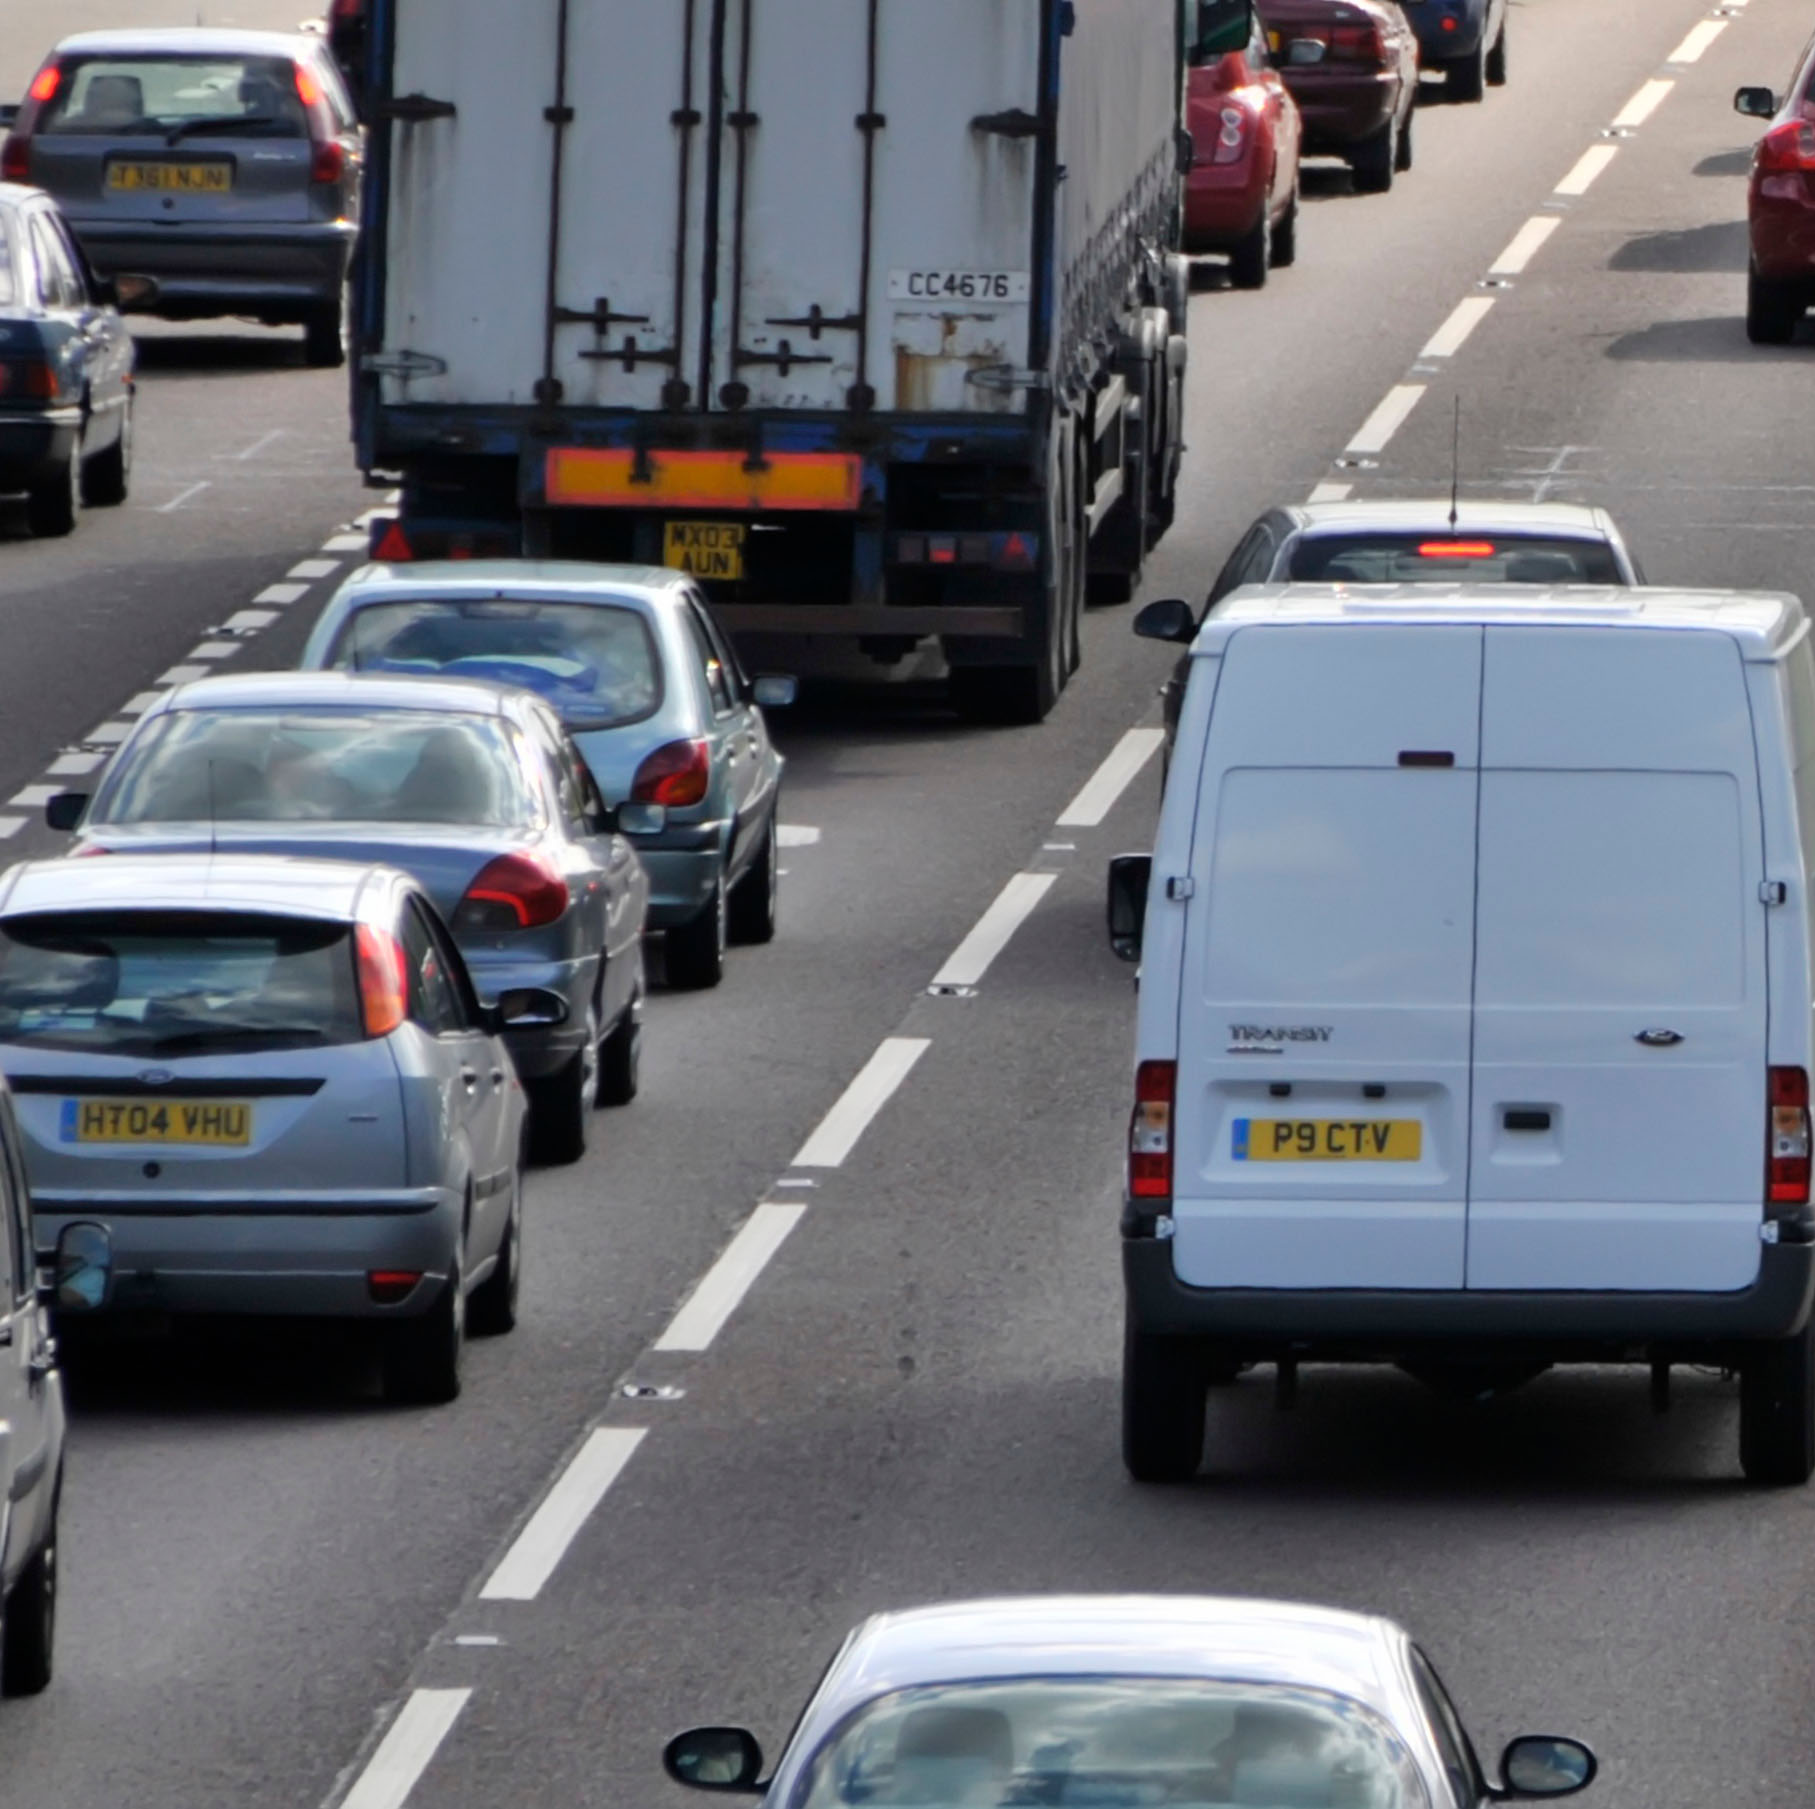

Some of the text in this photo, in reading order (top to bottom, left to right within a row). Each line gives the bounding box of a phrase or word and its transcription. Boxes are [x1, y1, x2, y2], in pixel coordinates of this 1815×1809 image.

[908, 272, 1010, 298] CC4676
[672, 525, 738, 548] MX03
[681, 551, 730, 575] AUN
[1229, 1024, 1334, 1042] TRANSIT
[84, 1105, 245, 1137] HT04 VHU
[1272, 1122, 1392, 1154] P9 CTV
